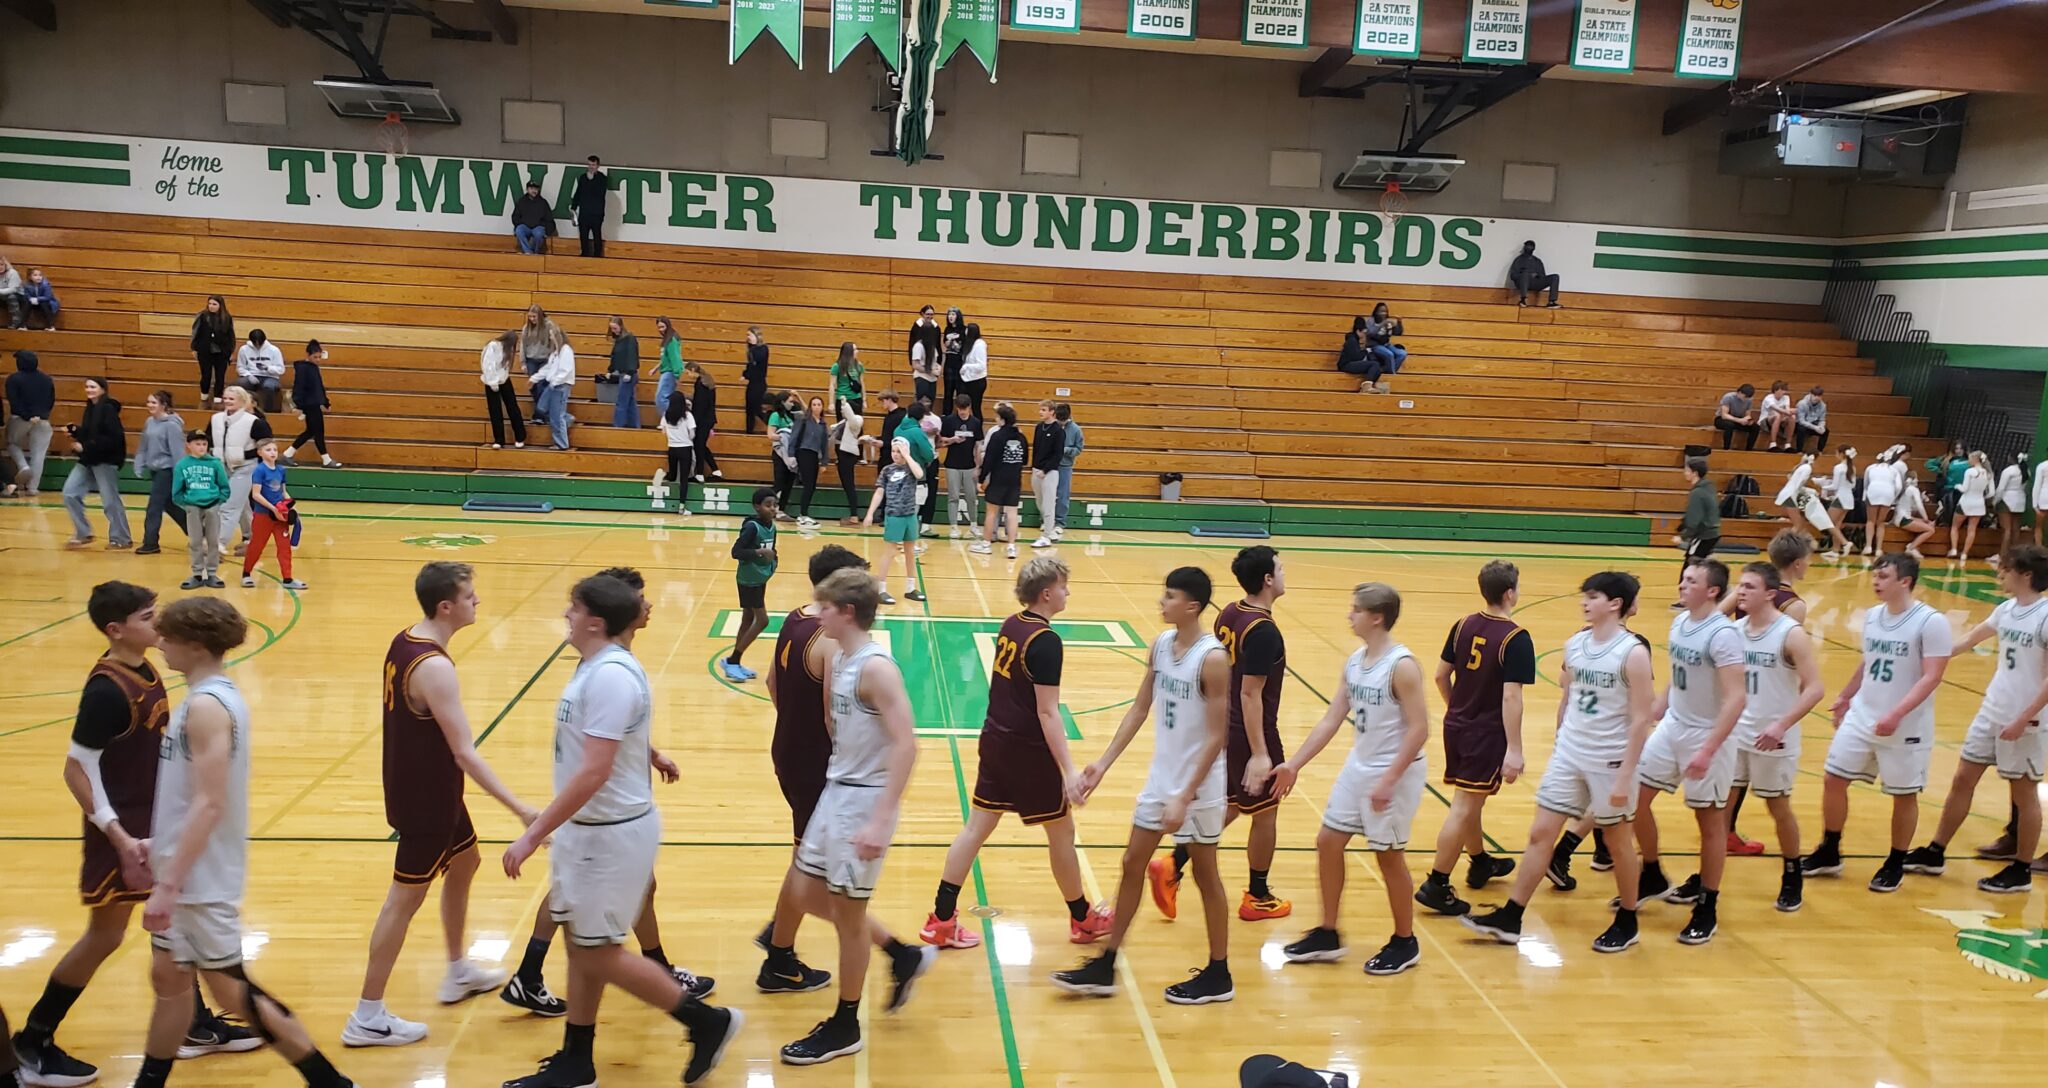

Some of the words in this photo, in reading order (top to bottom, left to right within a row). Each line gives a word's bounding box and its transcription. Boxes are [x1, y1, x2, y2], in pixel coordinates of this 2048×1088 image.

[836, 4, 853, 12] 2016
[857, 5, 875, 13] 2017
[880, 6, 896, 15] 2018
[957, 3, 973, 11] 2013
[978, 4, 994, 13] 2014
[1136, 0, 1190, 9] CHAMPIONS
[1250, 5, 1303, 18] CHAMPIONS
[1369, 2, 1382, 13] 2A
[1383, 3, 1411, 15] STATE
[836, 13, 853, 21] 2019
[857, 14, 874, 22] 2023
[957, 12, 973, 20] 2018
[978, 14, 994, 22] 2019
[1026, 5, 1065, 20] 1993
[1479, 11, 1491, 21] 2A
[1493, 11, 1520, 23] STATE
[1606, 8, 1632, 17] TRACK
[1140, 13, 1184, 29] 2006
[1363, 13, 1415, 27] CHAMPIONS
[1586, 19, 1598, 30] 2A
[1599, 20, 1627, 32] STATE
[1712, 16, 1737, 24] TRACK
[1254, 22, 1297, 37] 2022
[1473, 22, 1524, 35] CHAMPIONS
[1692, 26, 1703, 37] 2A
[1705, 28, 1732, 39] STATE
[1367, 30, 1409, 45] 2022
[1580, 30, 1630, 44] CHAMPIONS
[1685, 37, 1735, 51] CHAMPIONS
[1476, 39, 1518, 53] 2023
[1582, 47, 1624, 62] 2022
[1687, 54, 1729, 69] 2023
[161, 145, 223, 173] Home
[155, 174, 178, 202] of
[187, 175, 220, 198] the
[859, 183, 1484, 270] THUNDERBIRDS
[993, 636, 1018, 680] 22
[1466, 635, 1487, 671] 5
[2005, 647, 2017, 671] 5
[1869, 657, 1894, 683] 45
